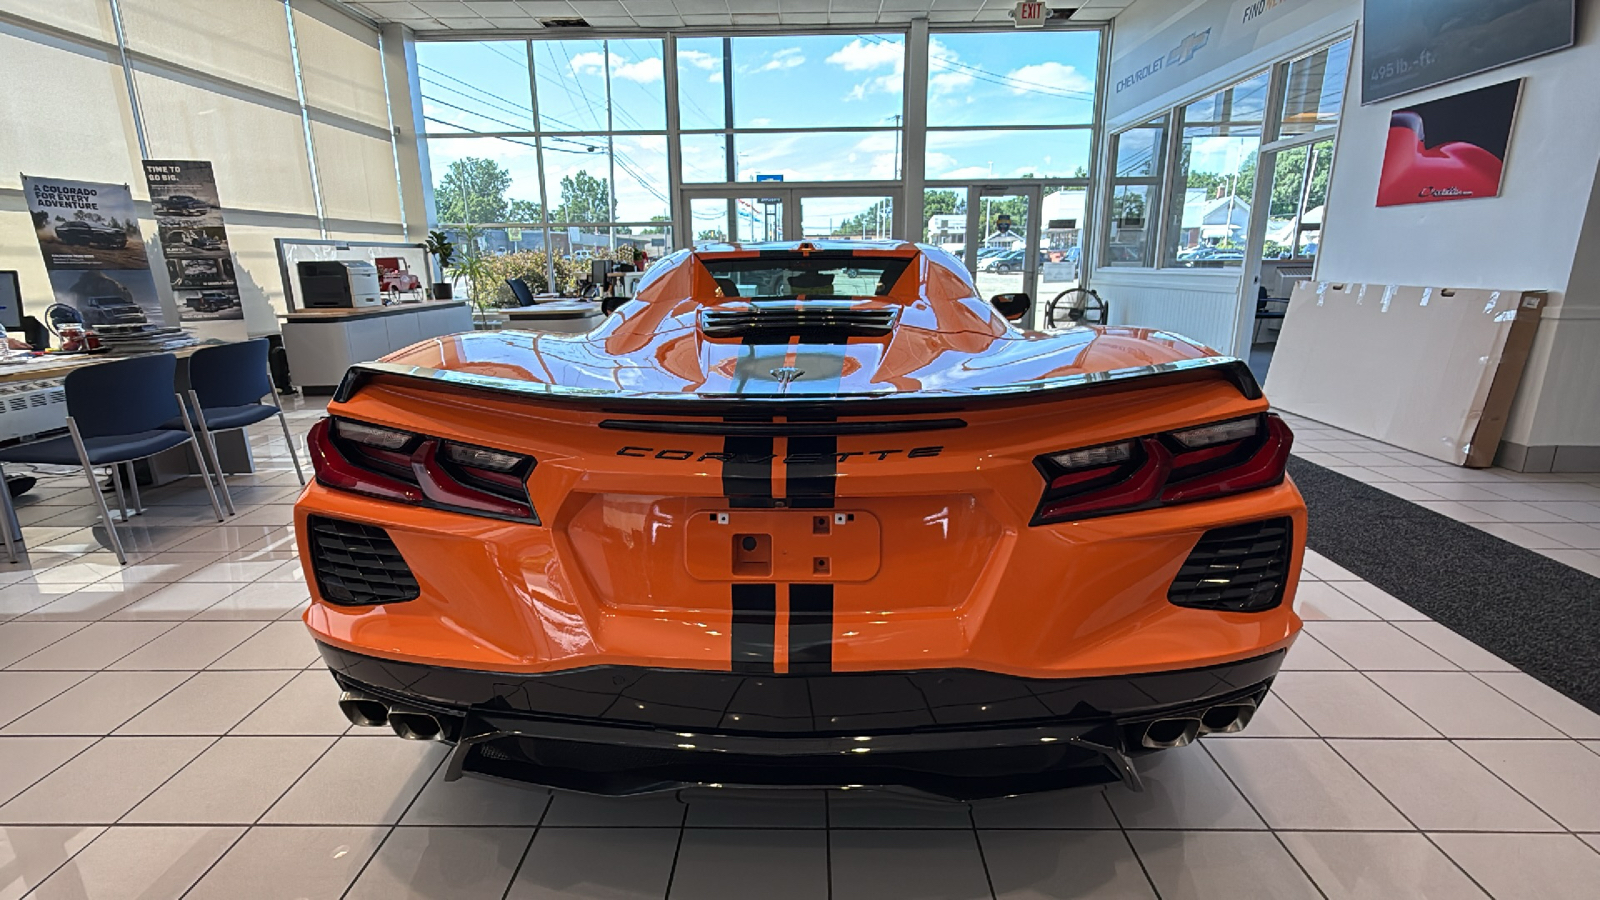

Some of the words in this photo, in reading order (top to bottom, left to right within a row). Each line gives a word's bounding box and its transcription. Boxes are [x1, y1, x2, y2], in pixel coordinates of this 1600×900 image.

[1021, 3, 1042, 19] EXIT
[1242, 0, 1266, 24] FIND
[1116, 55, 1165, 94] CHEVROLET
[1371, 62, 1394, 80] 495
[146, 165, 168, 173] TIME
[34, 191, 56, 200] FOR
[57, 193, 90, 203] EVERY
[42, 185, 98, 197] COLORADO
[37, 199, 99, 211] ADVENTURE
[616, 445, 945, 464] CORVETTE
